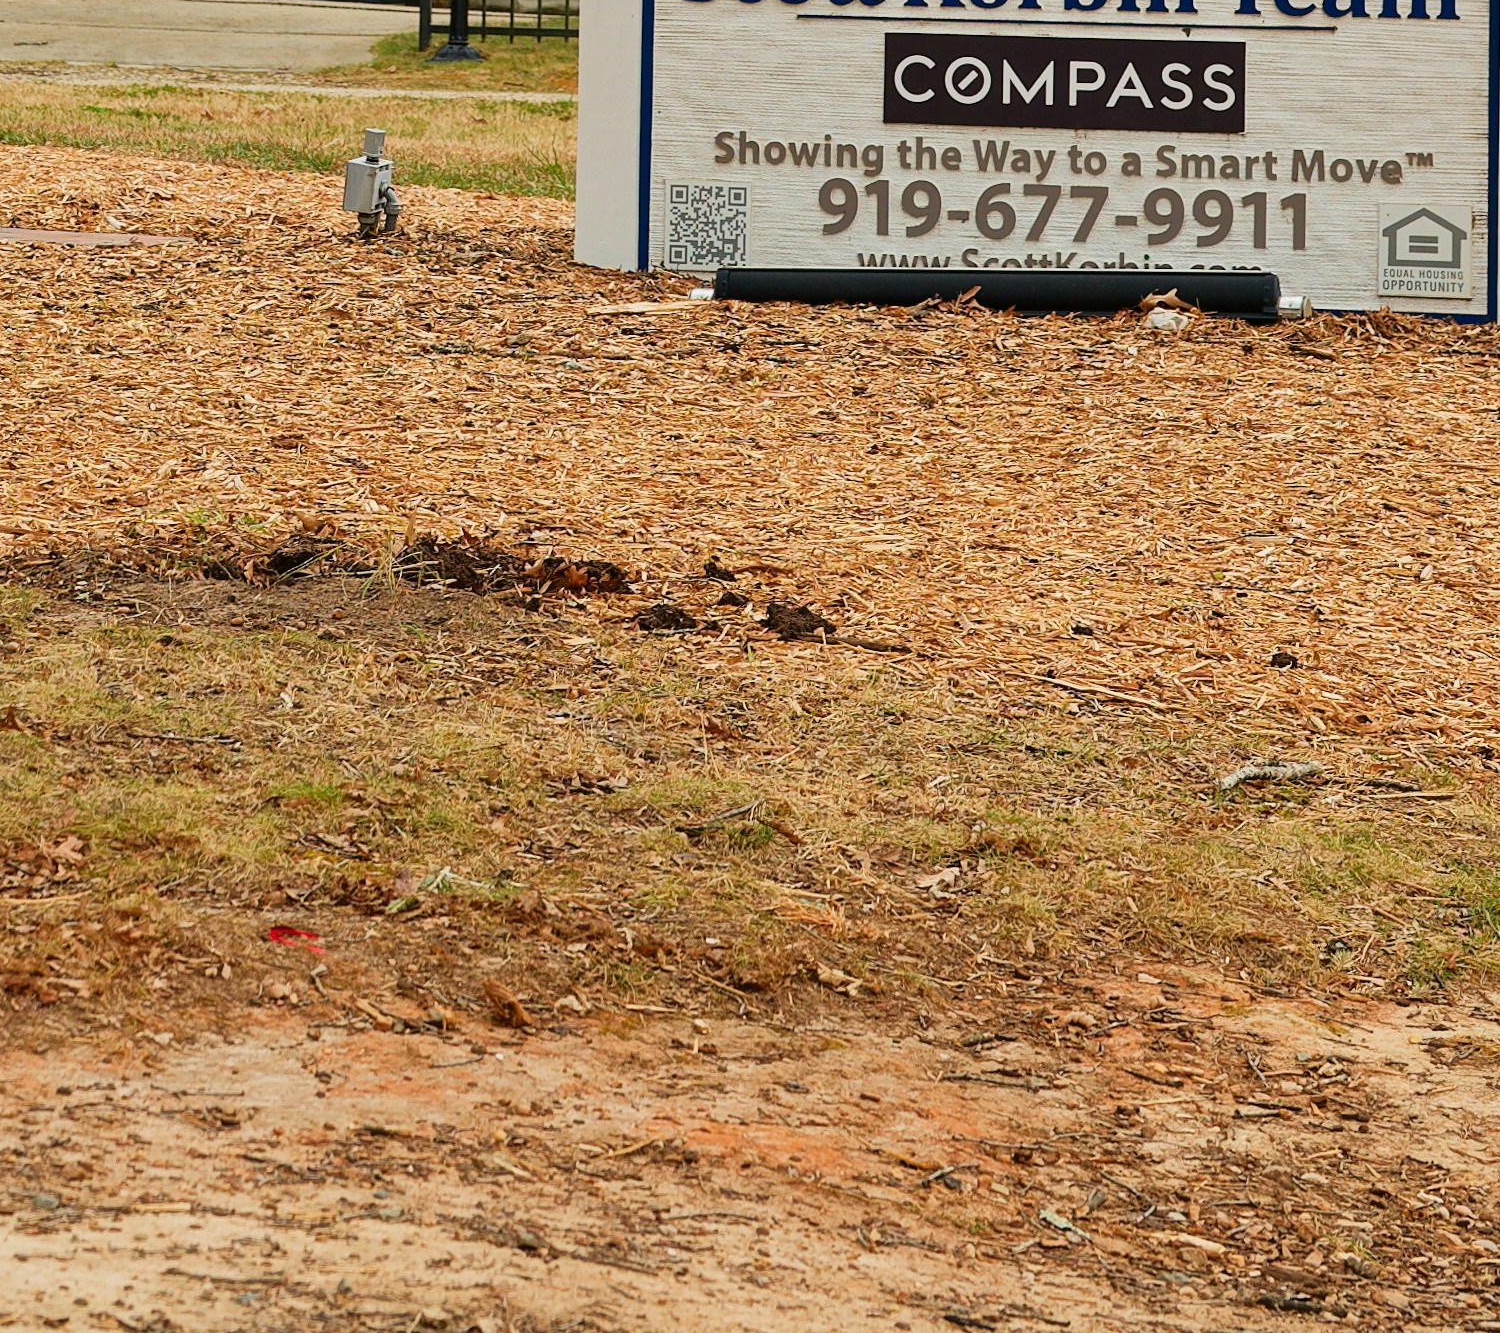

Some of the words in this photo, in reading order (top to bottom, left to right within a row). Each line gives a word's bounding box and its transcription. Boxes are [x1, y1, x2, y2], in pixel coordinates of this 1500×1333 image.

[894, 54, 1236, 112] COMPASS
[714, 131, 884, 177] Showing
[898, 136, 962, 171] the
[973, 139, 1056, 182] Way
[1067, 144, 1107, 175] to
[1121, 151, 1142, 177] a
[1156, 145, 1278, 181] Smart
[817, 177, 1307, 250] 919-677-9911
[1382, 279, 1464, 293] OPPORTUNITY
[1383, 268, 1415, 278] EQUAL
[1419, 270, 1464, 280] HOUSING
